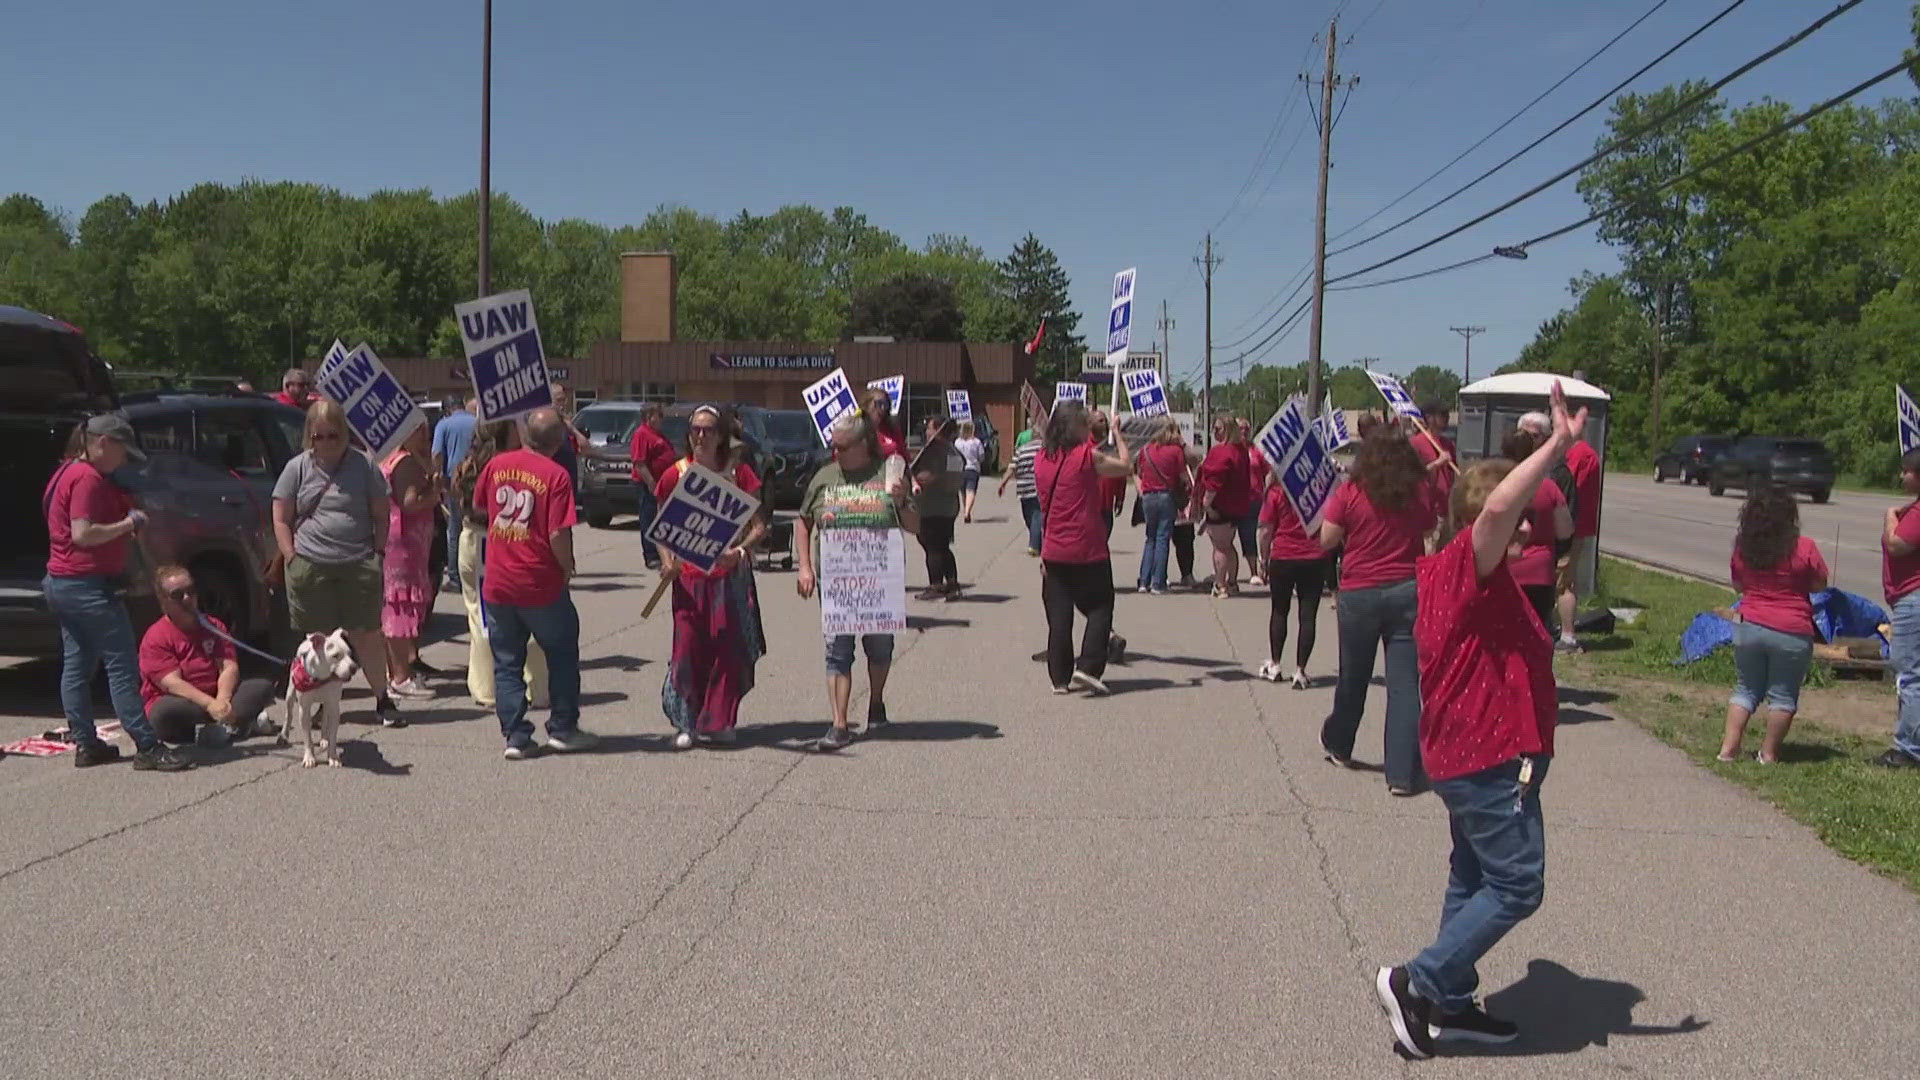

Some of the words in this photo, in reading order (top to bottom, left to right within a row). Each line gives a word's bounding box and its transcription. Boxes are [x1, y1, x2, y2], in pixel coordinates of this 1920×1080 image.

[1115, 271, 1134, 299] UAW
[462, 302, 527, 342] UAW
[1114, 307, 1125, 328] ON
[494, 343, 521, 377] ON
[731, 355, 760, 368] LEARN
[764, 356, 776, 368] TO
[811, 356, 833, 368] DIVE
[1087, 356, 1156, 370] UNWATER
[324, 351, 375, 404] UAW
[482, 361, 545, 416] STRIKE
[807, 375, 842, 406] UAW
[1059, 384, 1083, 398] UAW
[1126, 371, 1156, 392] UAW
[361, 391, 383, 418] ON
[826, 398, 842, 420] ON
[1140, 392, 1153, 405] ON
[365, 393, 410, 446] STRIKE
[1261, 403, 1305, 465] UAW
[1294, 452, 1315, 482] ON
[684, 472, 750, 521] UAW
[1299, 455, 1334, 517] STRIKE
[684, 512, 715, 536] ON
[653, 521, 723, 558] STRIKE
